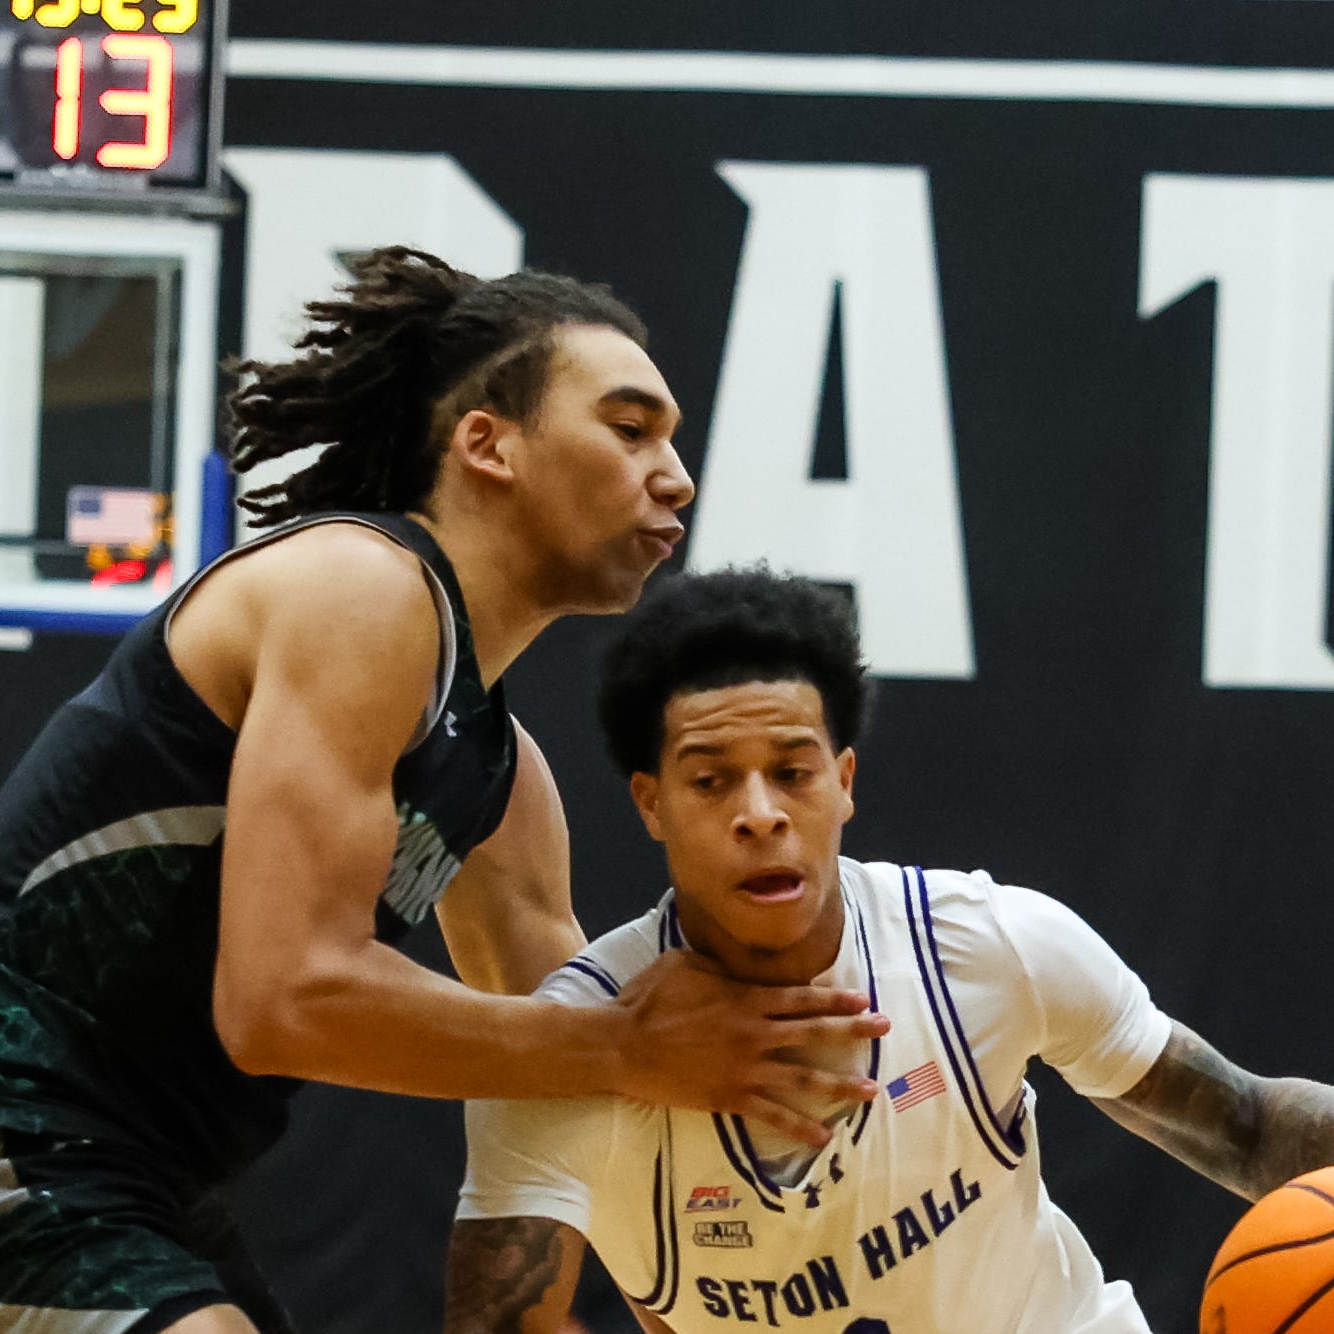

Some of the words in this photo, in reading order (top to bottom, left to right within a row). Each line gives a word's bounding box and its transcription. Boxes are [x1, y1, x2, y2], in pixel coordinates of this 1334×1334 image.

[52, 33, 174, 170] 13
[696, 1255, 851, 1328] SETON
[857, 1167, 982, 1281] HALL
